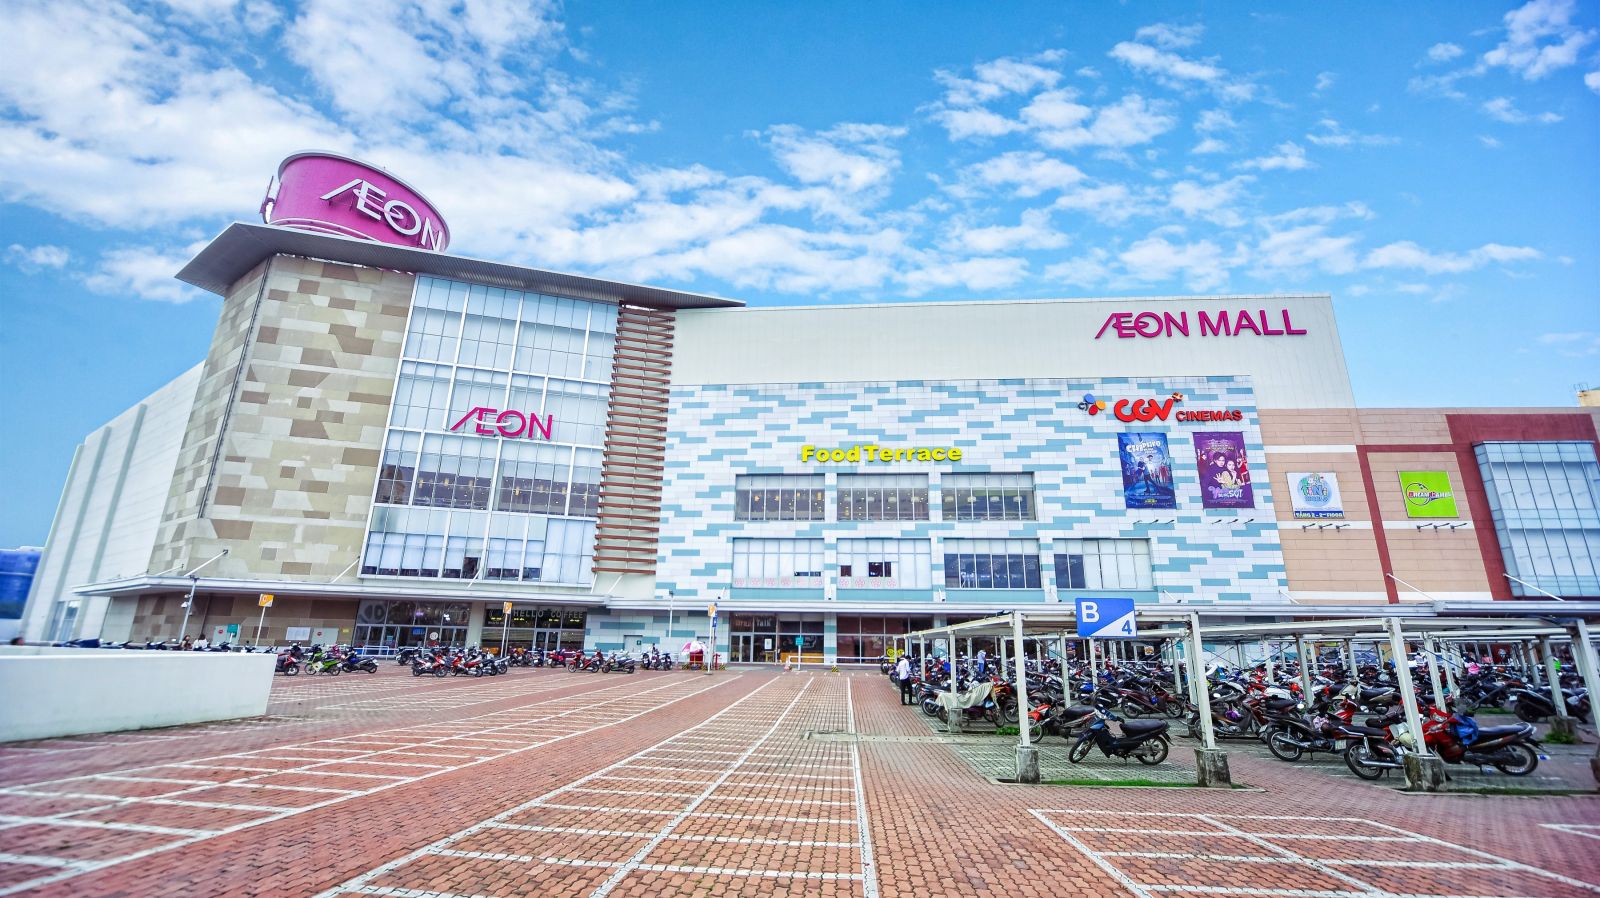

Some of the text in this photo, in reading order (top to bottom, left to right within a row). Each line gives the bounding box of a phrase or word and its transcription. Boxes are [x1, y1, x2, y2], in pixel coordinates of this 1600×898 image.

[1198, 309, 1307, 336] MALL
[1114, 397, 1243, 422] CGV CINEMAS
[801, 445, 962, 463] Food Terrace
[513, 609, 584, 619] HELLO COFFEE
[1081, 601, 1100, 622] B
[1122, 620, 1132, 634] 4
